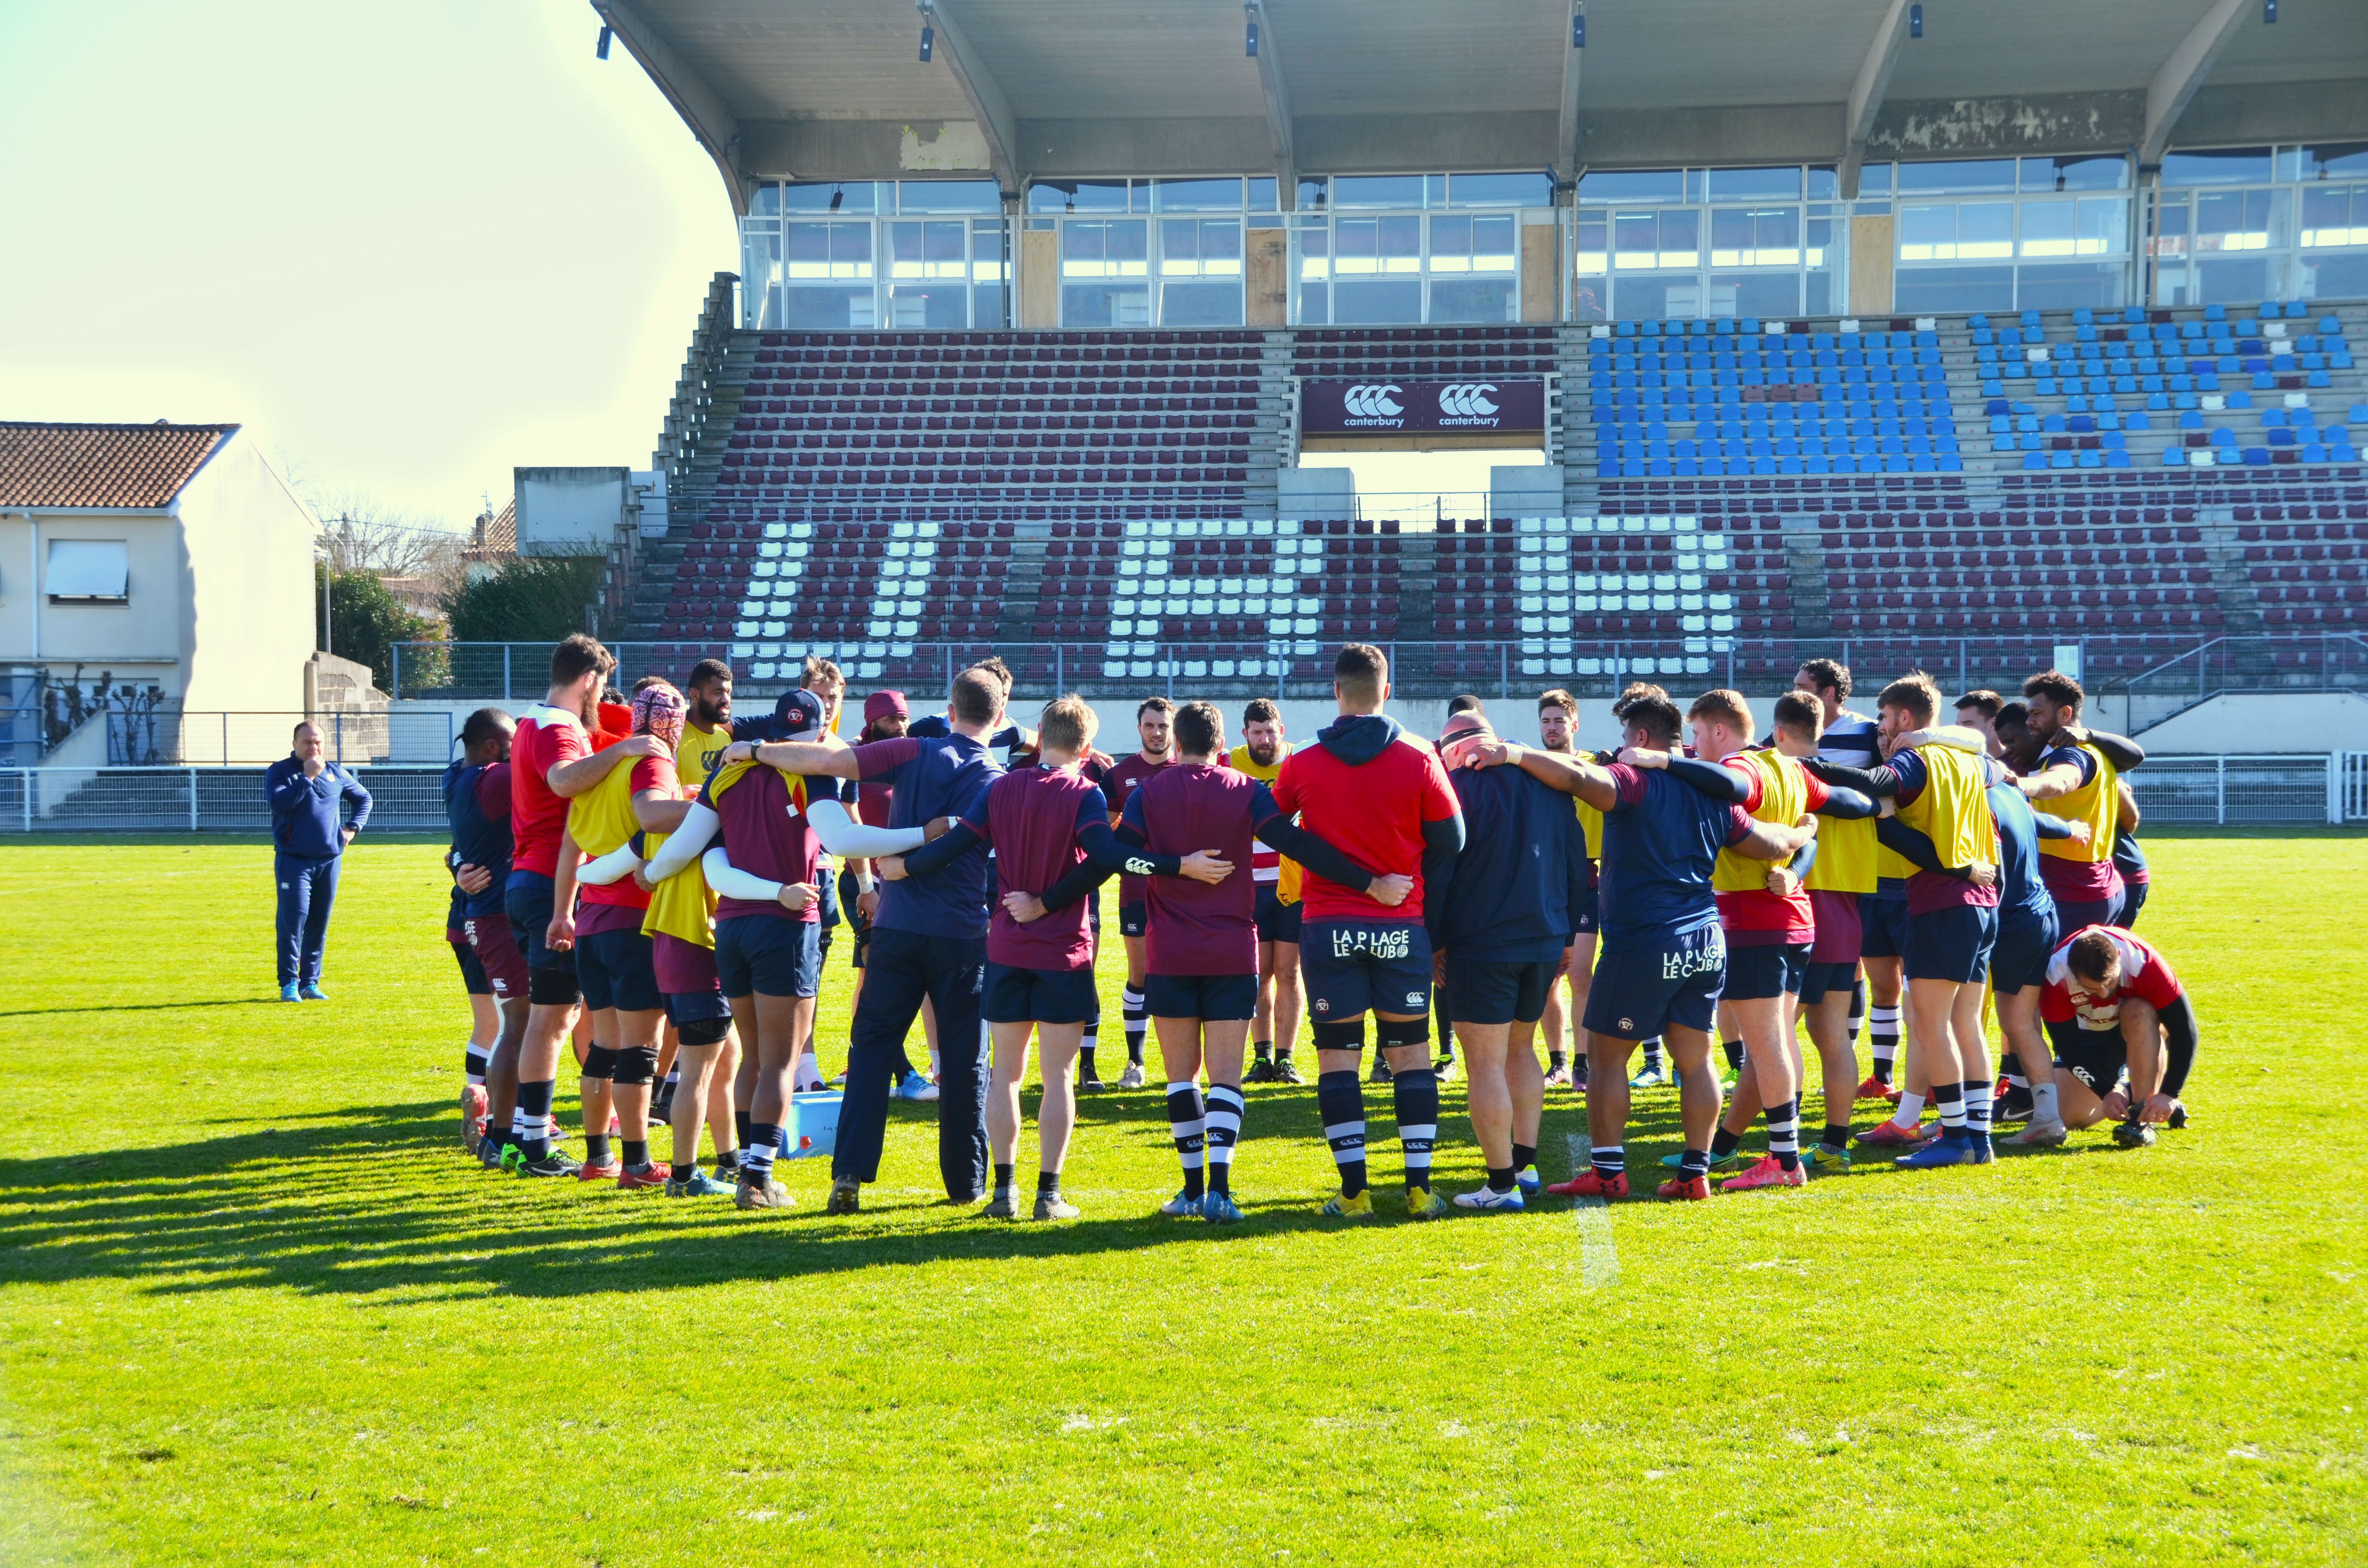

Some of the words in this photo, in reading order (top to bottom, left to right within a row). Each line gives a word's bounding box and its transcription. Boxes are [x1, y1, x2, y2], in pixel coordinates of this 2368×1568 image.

[1344, 416, 1405, 429] canterbury
[1439, 415, 1500, 428] canterbury
[1333, 930, 1353, 944] LA
[1334, 944, 1350, 957] LE
[1663, 952, 1682, 966] LA
[1663, 966, 1678, 979] LE
